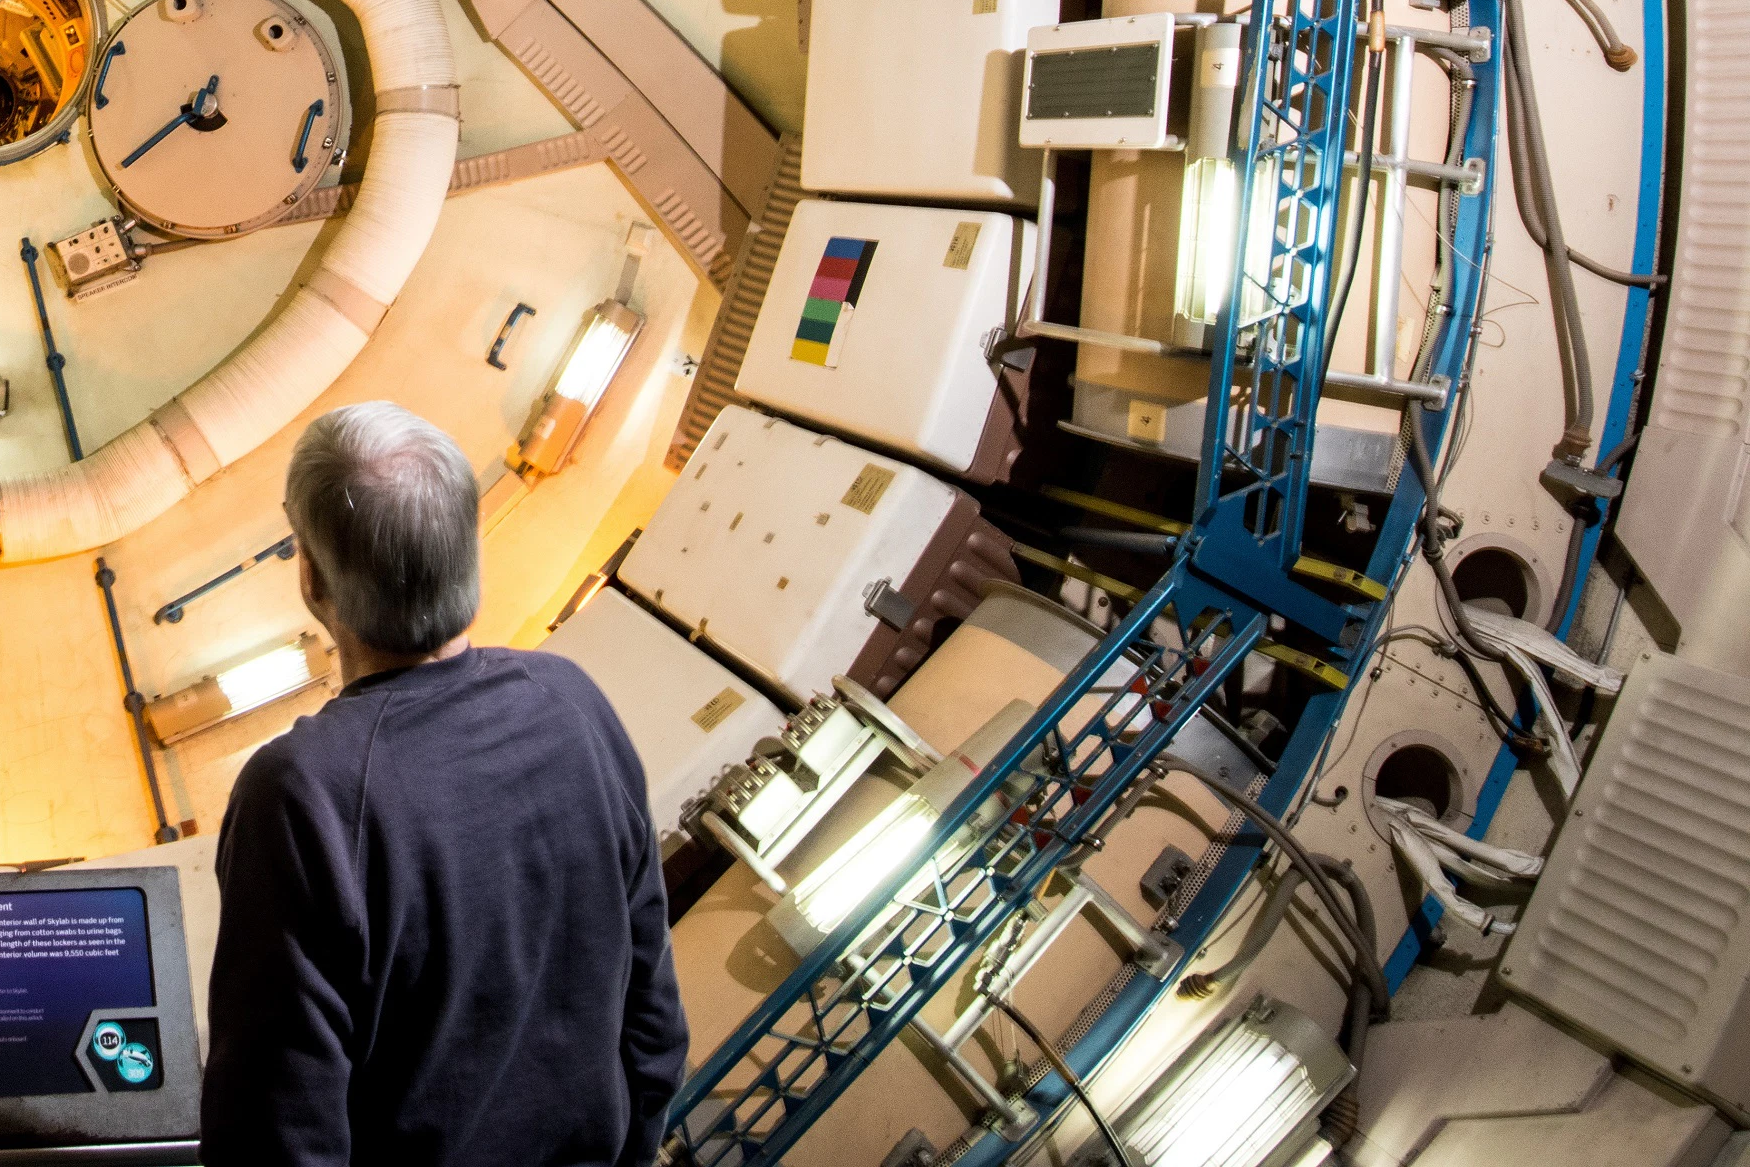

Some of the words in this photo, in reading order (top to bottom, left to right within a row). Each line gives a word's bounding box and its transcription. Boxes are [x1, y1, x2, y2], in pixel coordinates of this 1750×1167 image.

[77, 286, 107, 300] SPEAKER
[107, 273, 138, 289] INTERCOM
[47, 918, 70, 926] Skylab
[55, 928, 77, 936] swabs
[0, 940, 22, 948] length
[23, 939, 31, 947] of
[52, 938, 78, 946] lockers
[23, 950, 48, 958] volume
[103, 1036, 118, 1045] 114
